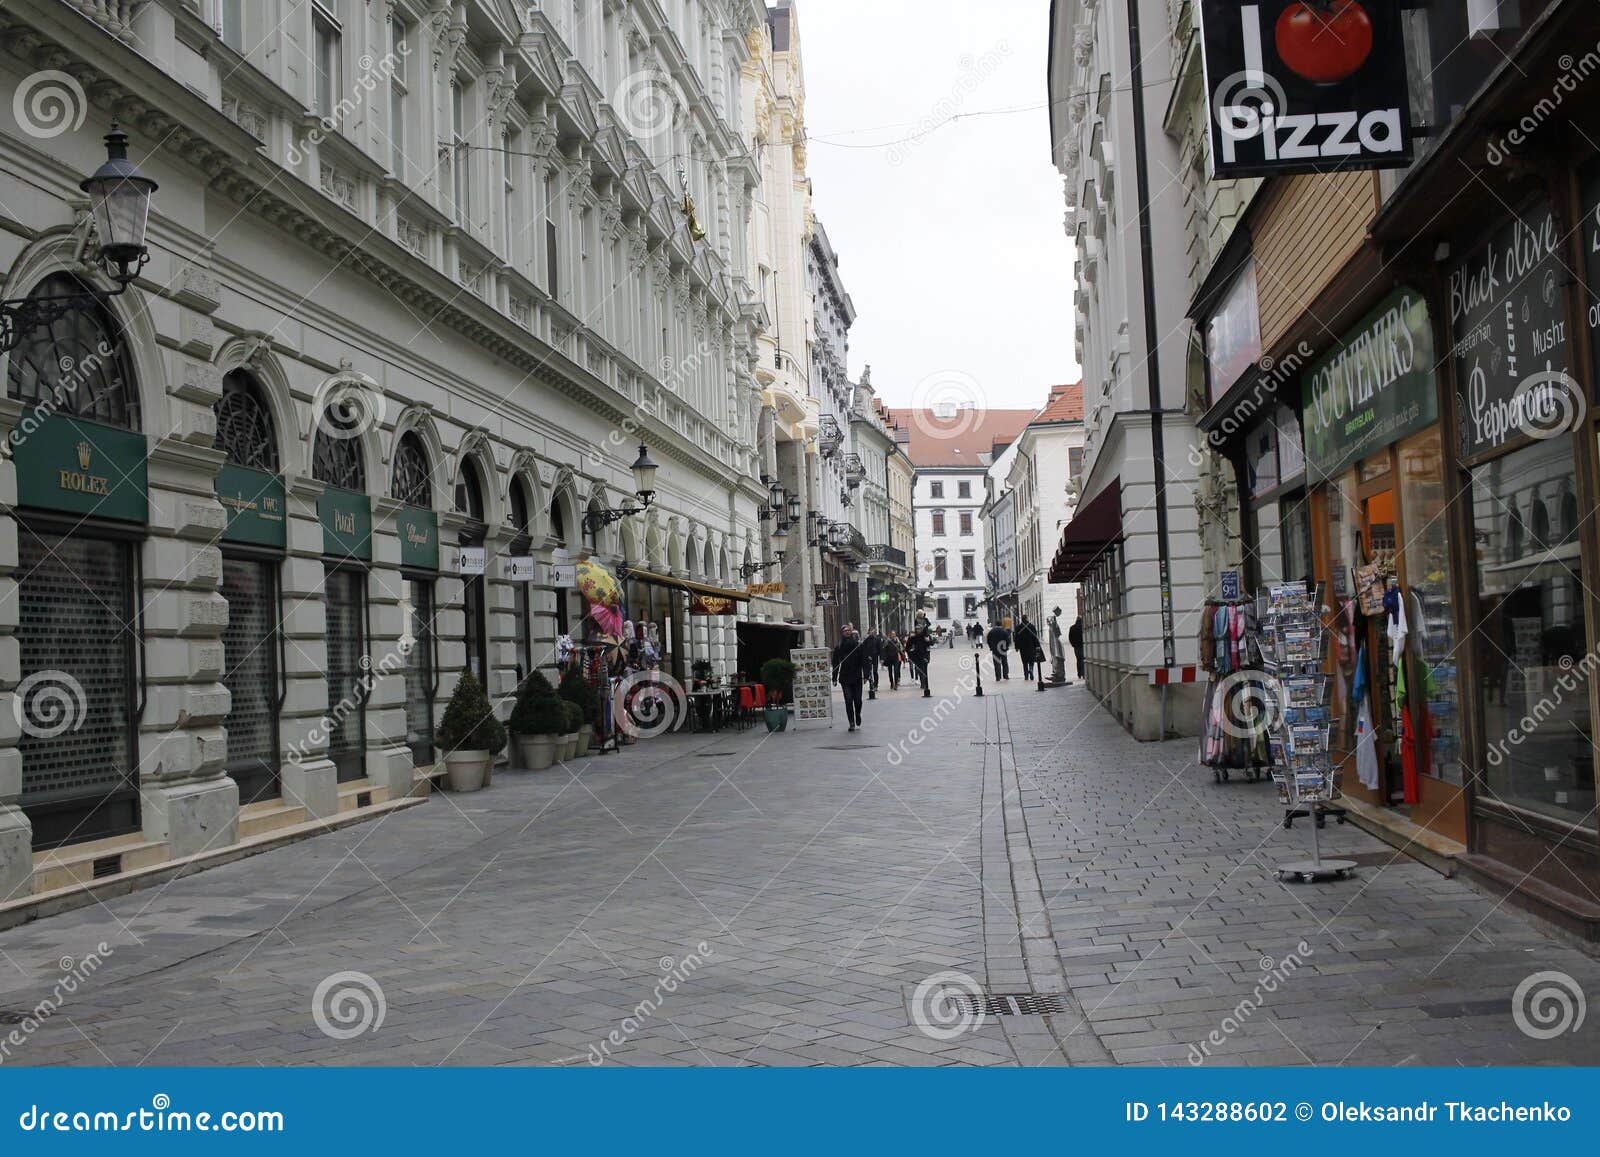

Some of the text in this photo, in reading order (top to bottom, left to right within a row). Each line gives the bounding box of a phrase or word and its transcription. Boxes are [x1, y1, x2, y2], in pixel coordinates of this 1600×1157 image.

[1219, 101, 1403, 163] Pizza
[1450, 243, 1499, 325] Black
[1312, 295, 1414, 434] SOUVENIRS
[1468, 356, 1556, 447] Pepperoni
[60, 470, 108, 495] ROLEX
